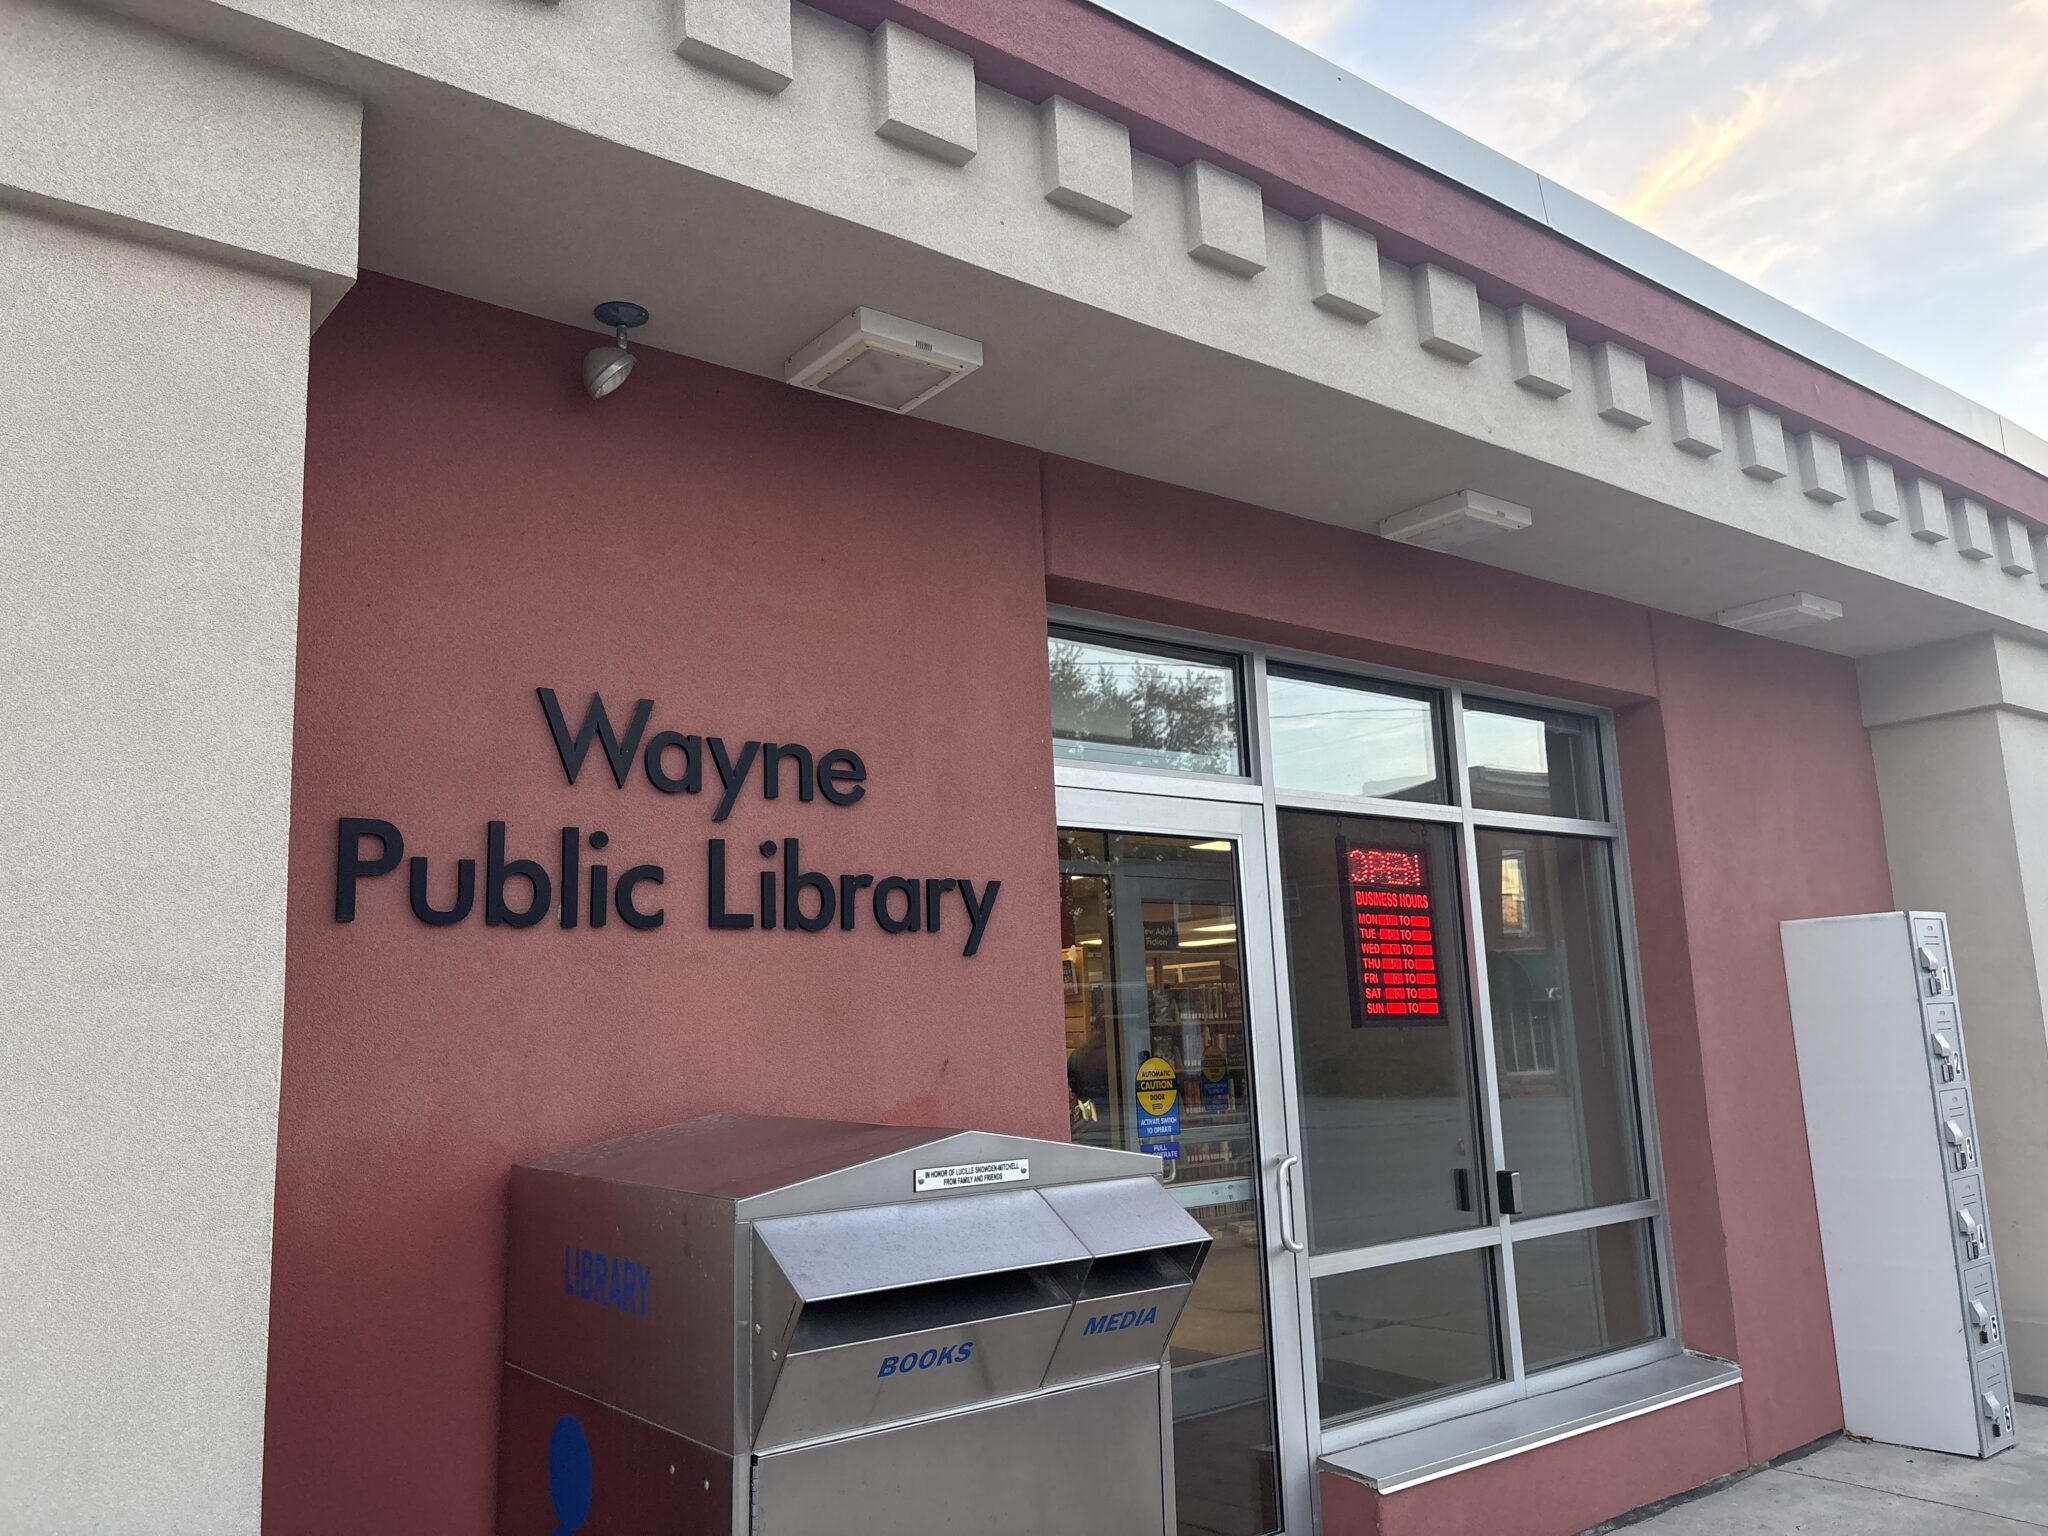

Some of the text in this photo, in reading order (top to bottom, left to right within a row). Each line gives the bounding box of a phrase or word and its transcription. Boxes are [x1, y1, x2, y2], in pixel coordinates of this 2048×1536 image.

[536, 687, 867, 822] Wayne
[1350, 849, 1421, 886] OPEN
[335, 816, 1002, 957] Public Library
[1356, 891, 1429, 909] BUSINESS HOURS
[1358, 913, 1378, 924] MON
[1399, 915, 1410, 926] TO
[1360, 928, 1376, 939] TUE
[1400, 929, 1411, 940] TO
[1361, 943, 1380, 954] WED
[1401, 944, 1413, 955] TO
[1363, 958, 1380, 969] THU
[1403, 959, 1414, 970] TO
[1364, 973, 1378, 983] FRI
[1404, 973, 1416, 984] TO
[1943, 967, 1949, 989] 1
[1365, 988, 1381, 999] SAT
[1405, 988, 1417, 999] TO
[1367, 1003, 1419, 1014] SUN TO
[1953, 1053, 1961, 1074] 2
[1142, 1070, 1171, 1078] AUTOMATIC
[1140, 1080, 1173, 1090] CAUTION
[1140, 1117, 1177, 1126] ACTIVATE SWITCH
[1147, 1125, 1172, 1134] TO OPERATE
[1966, 1138, 1973, 1160] 3
[925, 1171, 930, 1179] IN
[931, 1169, 948, 1178] HONOR
[948, 1168, 955, 1176] OF
[955, 1166, 975, 1176] LUCILLE
[943, 1172, 1003, 1186] FROM FAMILY AND FRIENDS
[1978, 1224, 1985, 1249] 4
[564, 1243, 651, 1317] LIBRARY
[1083, 1306, 1158, 1337] MEDIA
[1991, 1317, 1998, 1340] 5
[877, 1341, 974, 1378] BOOKS
[2004, 1407, 2011, 1431] 6
